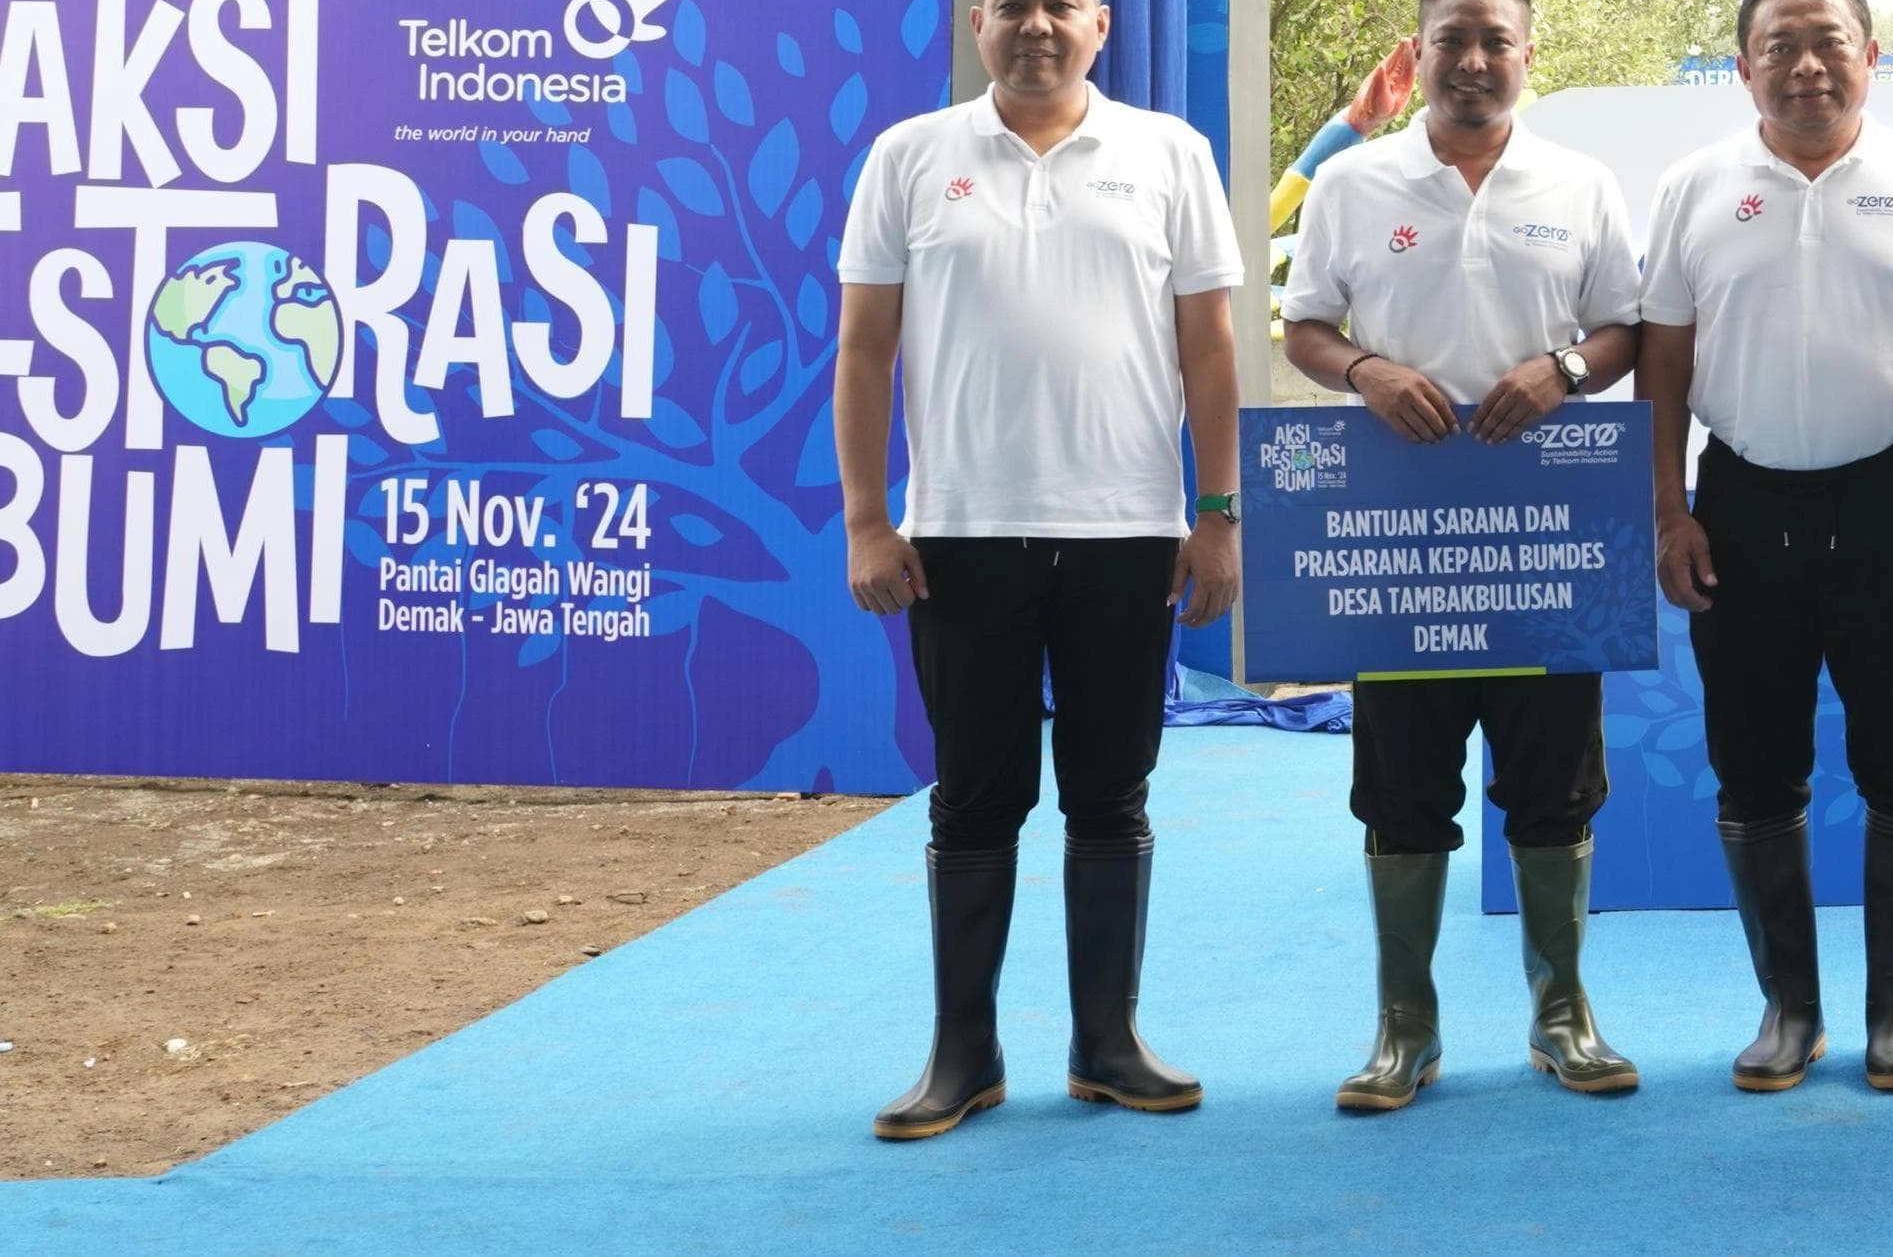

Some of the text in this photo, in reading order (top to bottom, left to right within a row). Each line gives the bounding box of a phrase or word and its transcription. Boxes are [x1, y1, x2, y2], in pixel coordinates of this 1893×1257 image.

[399, 19, 552, 58] Telkom
[419, 64, 626, 103] Indonesia
[394, 125, 591, 145] the world in your hand
[1275, 423, 1310, 445] AKSI
[1275, 468, 1315, 492] BUMI
[380, 478, 429, 544] 15
[448, 480, 555, 547] Nov.
[1327, 504, 1569, 538] BANTUAN SARANA DAN
[1295, 542, 1605, 577] PRASARANA KEPADA BUMDES
[380, 558, 651, 602] Pantai Glagah Wangi
[1329, 582, 1573, 616] DESA TAMBAKBULUSAN
[379, 601, 465, 633] Demak
[491, 603, 554, 635] Jawa
[562, 604, 651, 642] Tengah
[1414, 624, 1488, 652] DEMAK
